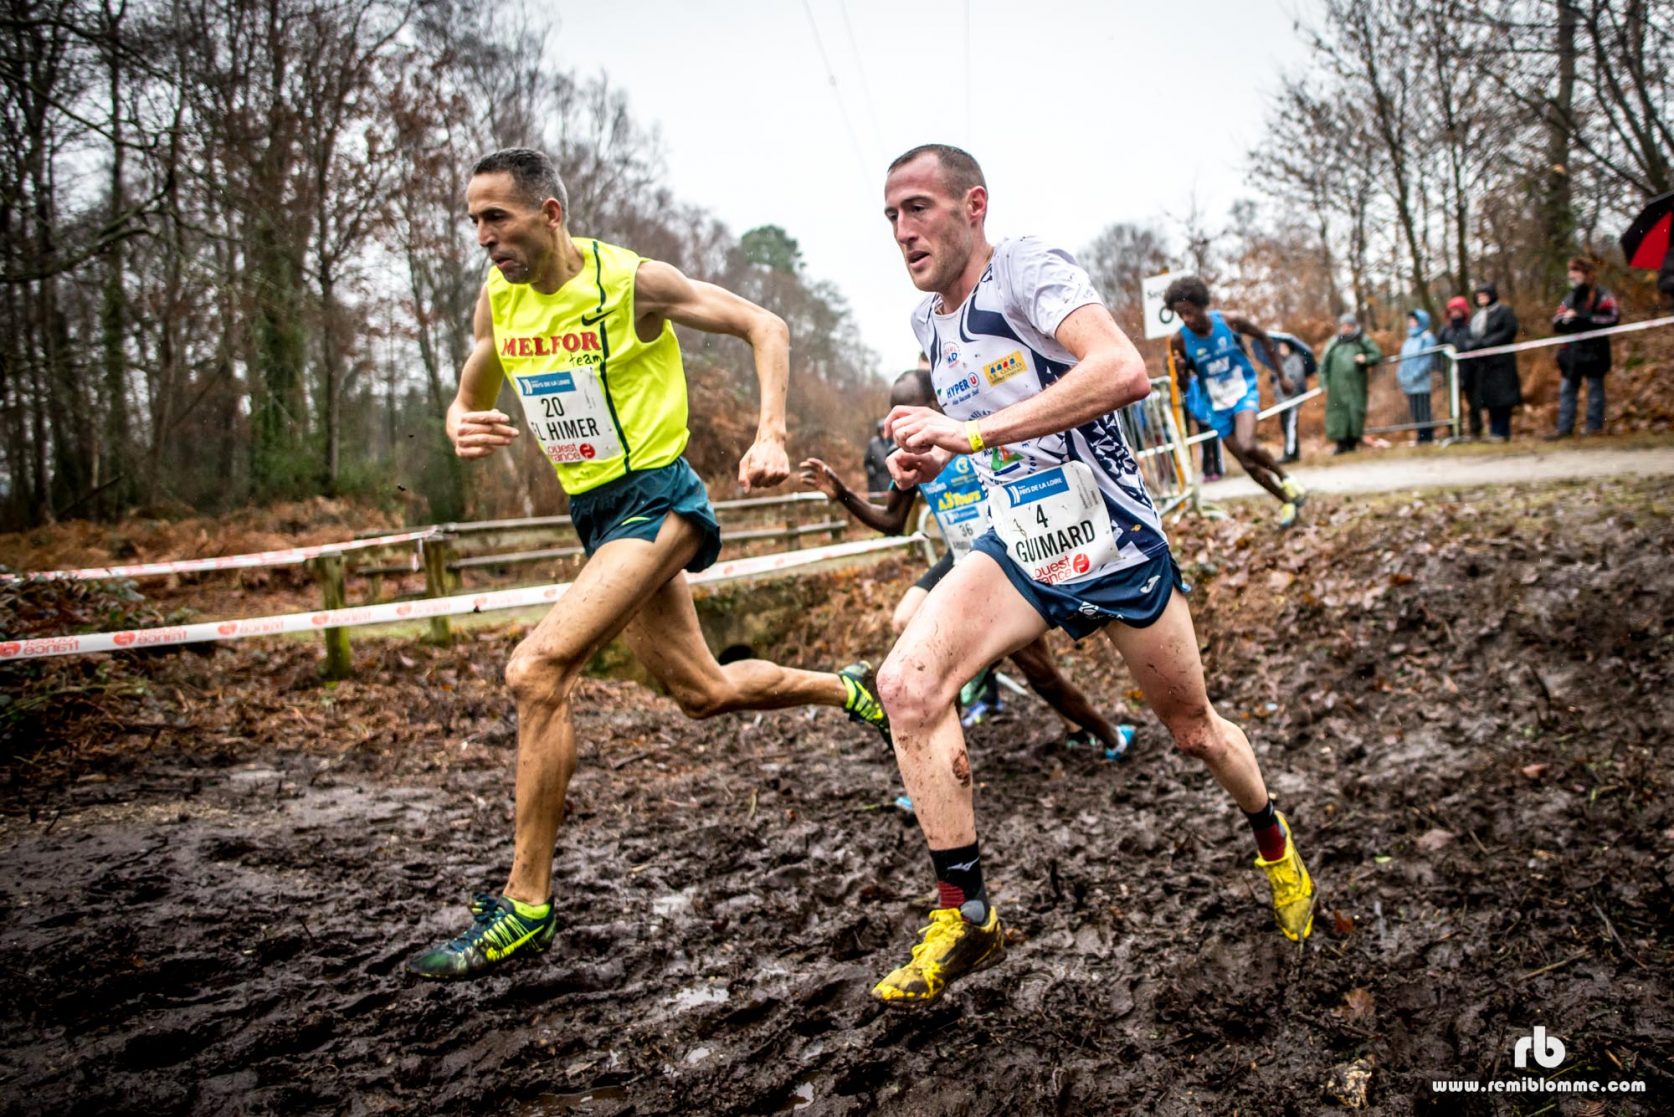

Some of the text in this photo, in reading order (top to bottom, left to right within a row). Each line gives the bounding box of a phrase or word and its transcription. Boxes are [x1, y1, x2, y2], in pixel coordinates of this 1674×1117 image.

[501, 332, 601, 356] MELFOR
[569, 354, 602, 366] team
[946, 379, 970, 399] HYPER
[541, 397, 565, 418] 20
[546, 417, 600, 441] HIMER
[1018, 487, 1031, 495] PAYS
[1047, 478, 1062, 487] LOIRE
[1036, 504, 1048, 528] 4
[958, 523, 973, 537] 36
[1015, 519, 1096, 563] GUIMARD
[1034, 555, 1071, 578] ouest
